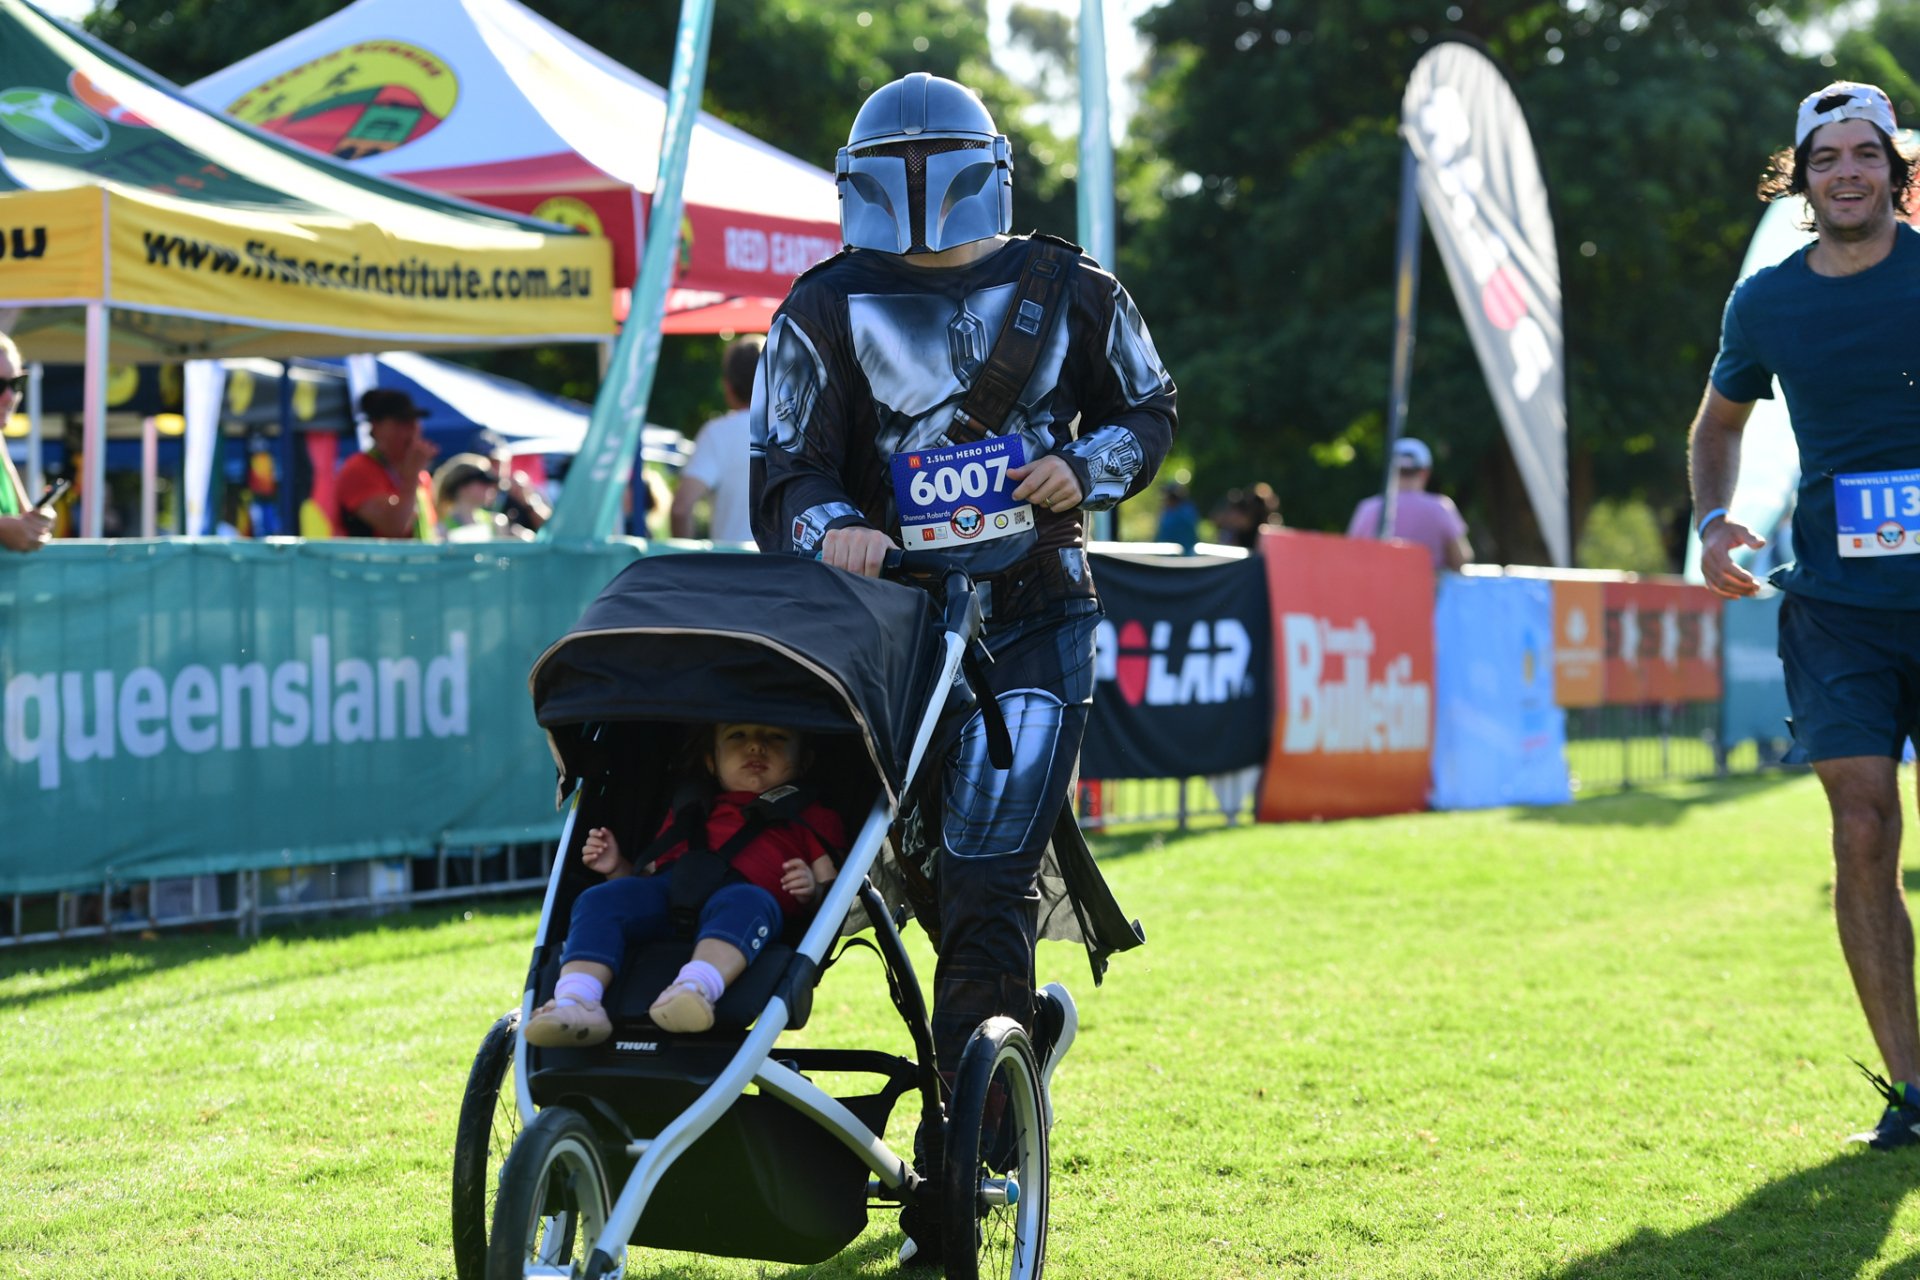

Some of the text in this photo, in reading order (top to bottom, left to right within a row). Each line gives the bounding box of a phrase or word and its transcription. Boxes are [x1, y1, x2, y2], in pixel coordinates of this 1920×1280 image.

[724, 227, 768, 272] RED
[926, 443, 1005, 464] 2.5km HERO RUN
[910, 455, 1010, 506] 6007
[903, 509, 951, 522] Shannon Robards
[1283, 612, 1429, 754] Bulletin
[3, 631, 469, 790] queensland
[615, 1041, 658, 1051] THULE
